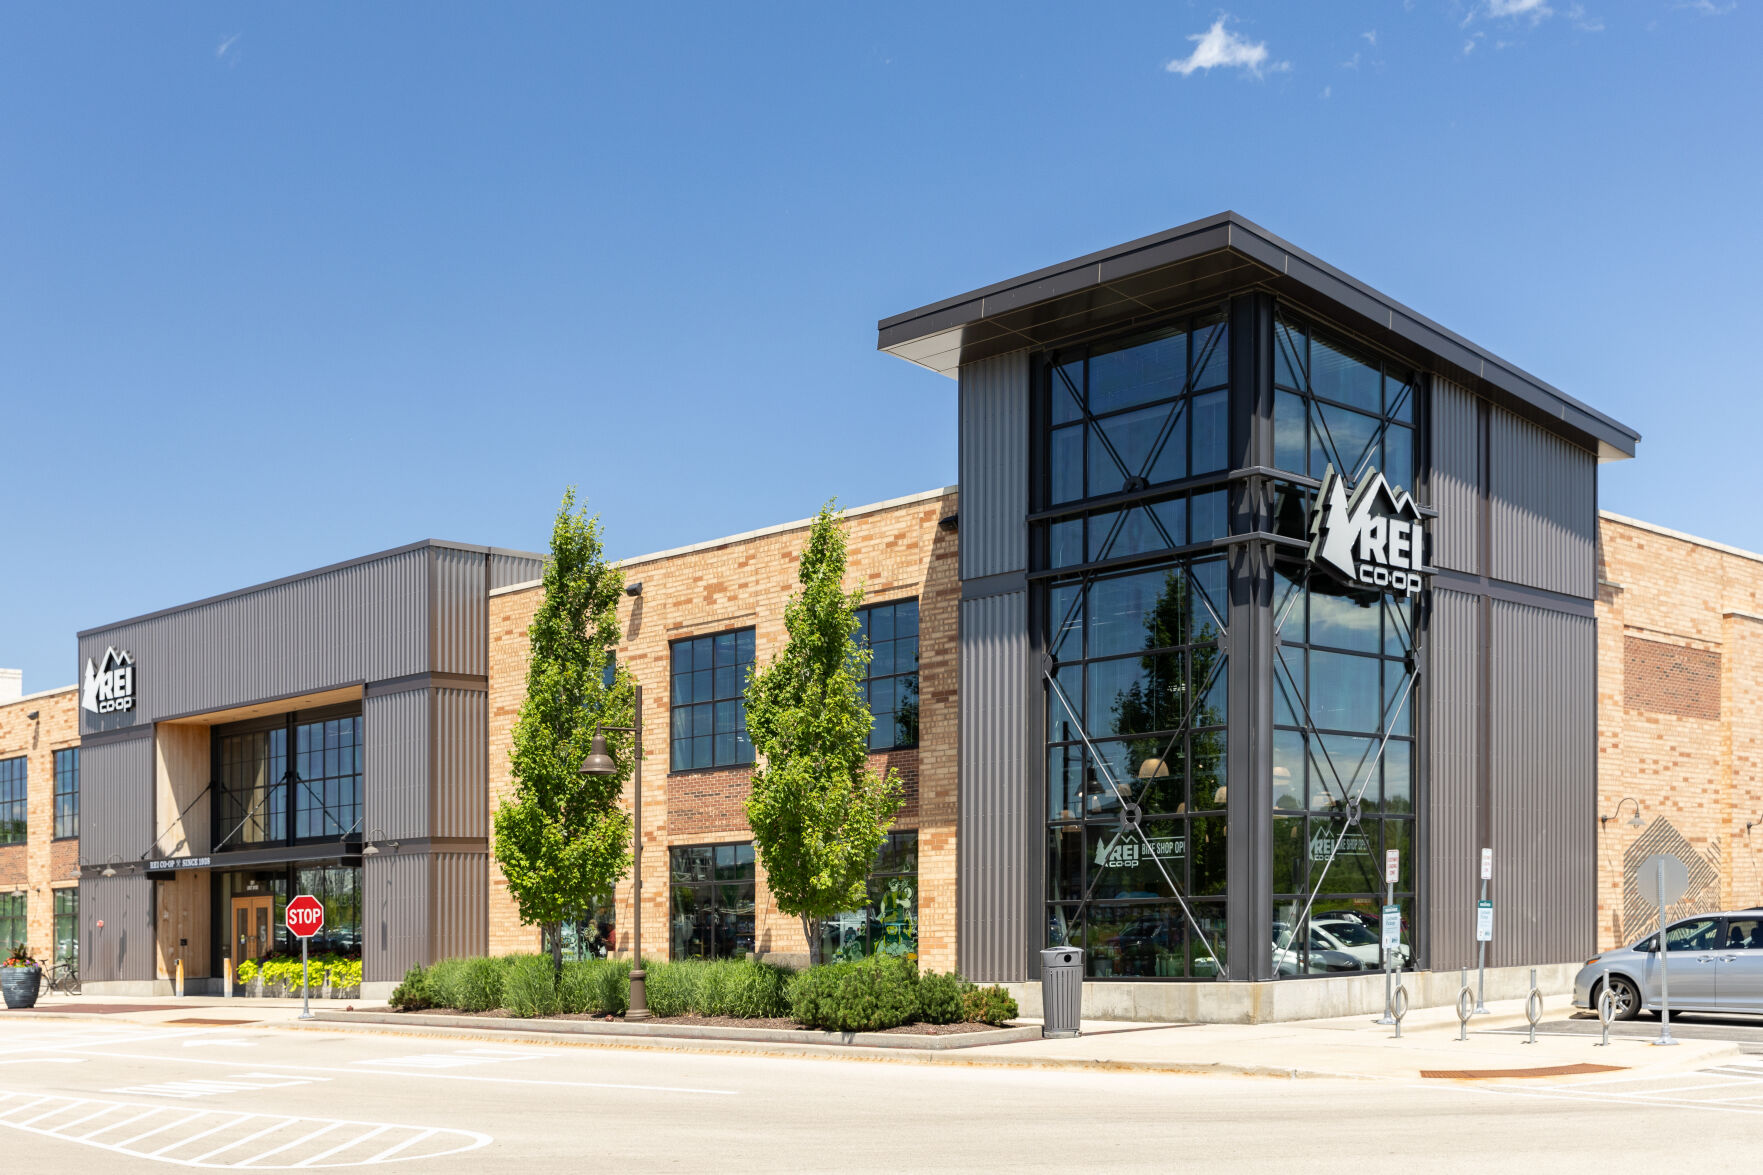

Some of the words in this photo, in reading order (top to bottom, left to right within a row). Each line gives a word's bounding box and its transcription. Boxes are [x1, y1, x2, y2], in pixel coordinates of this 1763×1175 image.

[1360, 515, 1423, 571] REI
[99, 666, 133, 701] REI
[1109, 844, 1139, 861] REI
[1156, 842, 1174, 854] SHOP
[1174, 841, 1186, 854] OP
[1314, 839, 1336, 855] REI
[182, 858, 199, 867] SINCE
[289, 908, 321, 925] STOP
